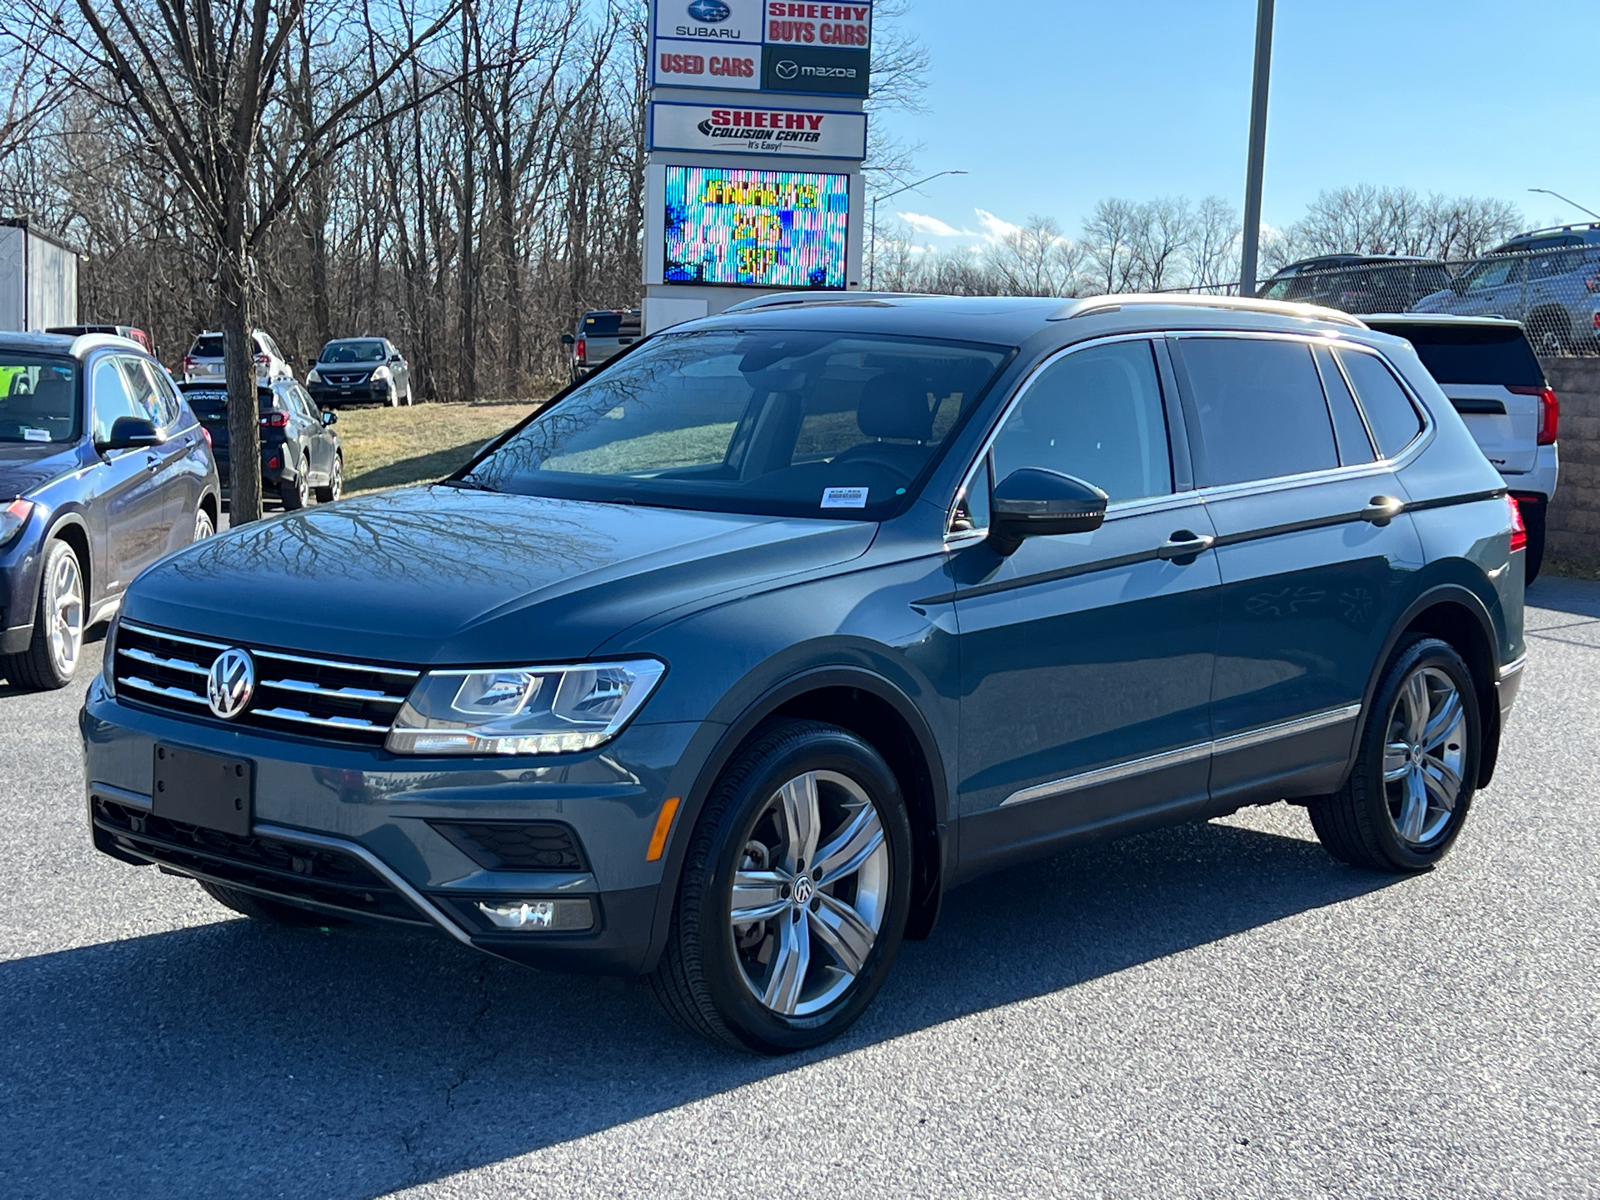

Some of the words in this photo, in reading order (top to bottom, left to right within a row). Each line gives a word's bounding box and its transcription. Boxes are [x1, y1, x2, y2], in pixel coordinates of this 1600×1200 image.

[769, 2, 868, 21] SHEEHY
[675, 26, 741, 39] SUBARU
[769, 19, 815, 43] BUYS
[819, 22, 868, 46] CARS
[660, 52, 705, 75] USED
[709, 56, 754, 78] CARS
[801, 66, 857, 78] mazda
[711, 109, 824, 130] SHEEHY
[711, 127, 775, 140] COLLISION
[775, 130, 821, 142] CENTER
[747, 140, 760, 150] It's
[760, 141, 782, 152] Easy!
